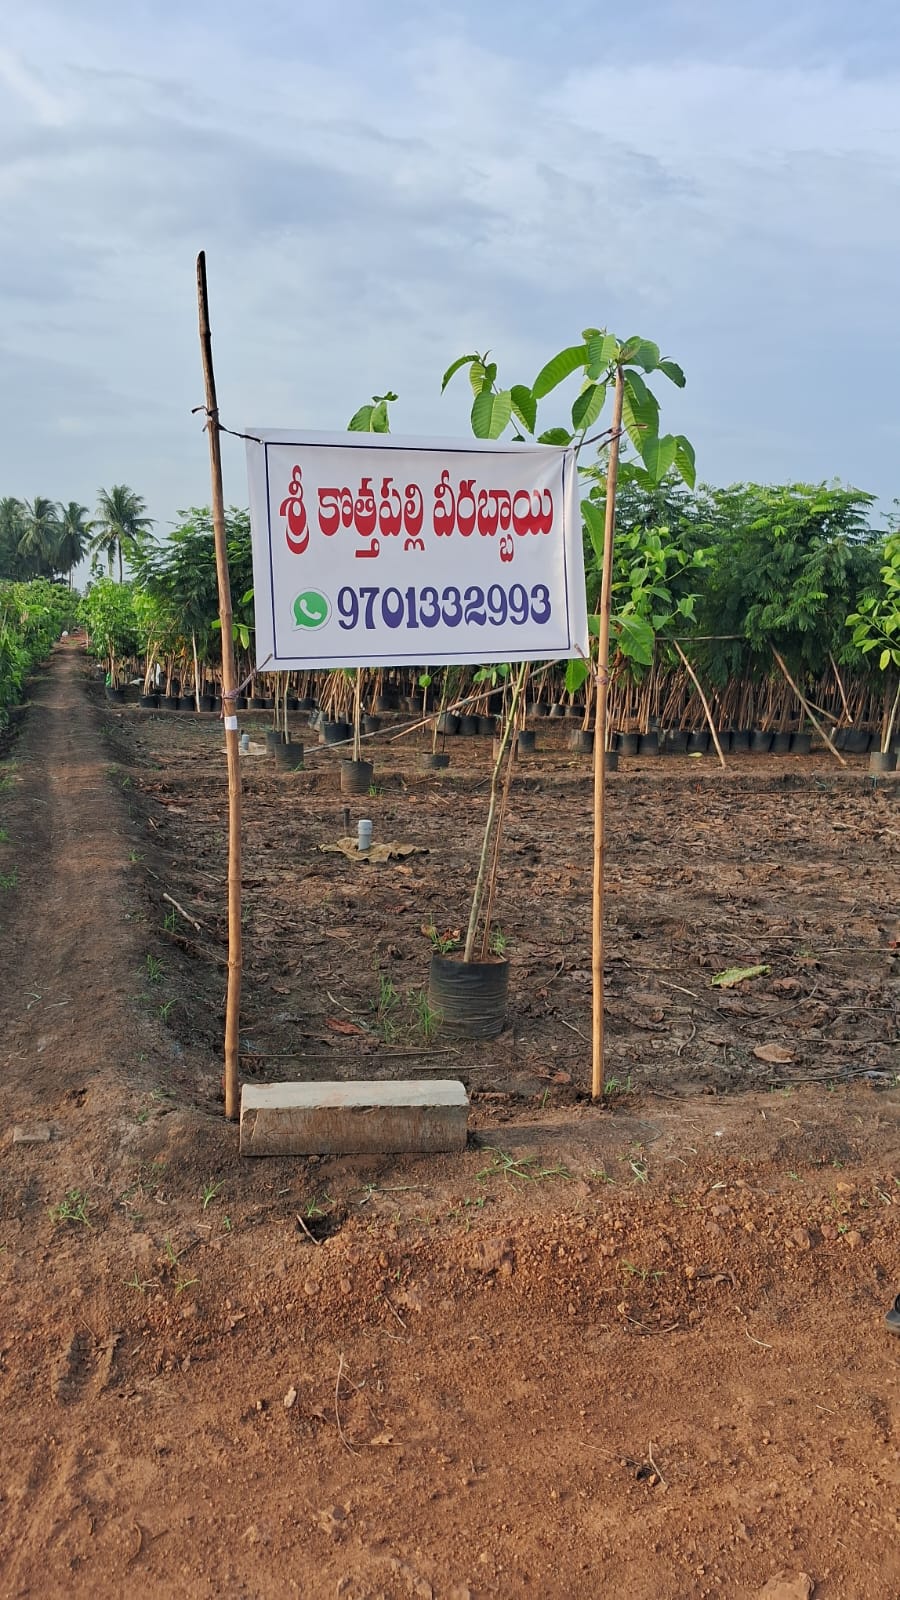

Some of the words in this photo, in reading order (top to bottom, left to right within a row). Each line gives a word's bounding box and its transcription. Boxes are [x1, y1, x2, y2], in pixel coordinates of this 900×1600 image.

[279, 465, 310, 555] శ్రీ
[317, 477, 426, 558] కొత్తపల్లి
[432, 469, 554, 562] వీరబ్బాయి
[337, 584, 551, 630] 9701332993
